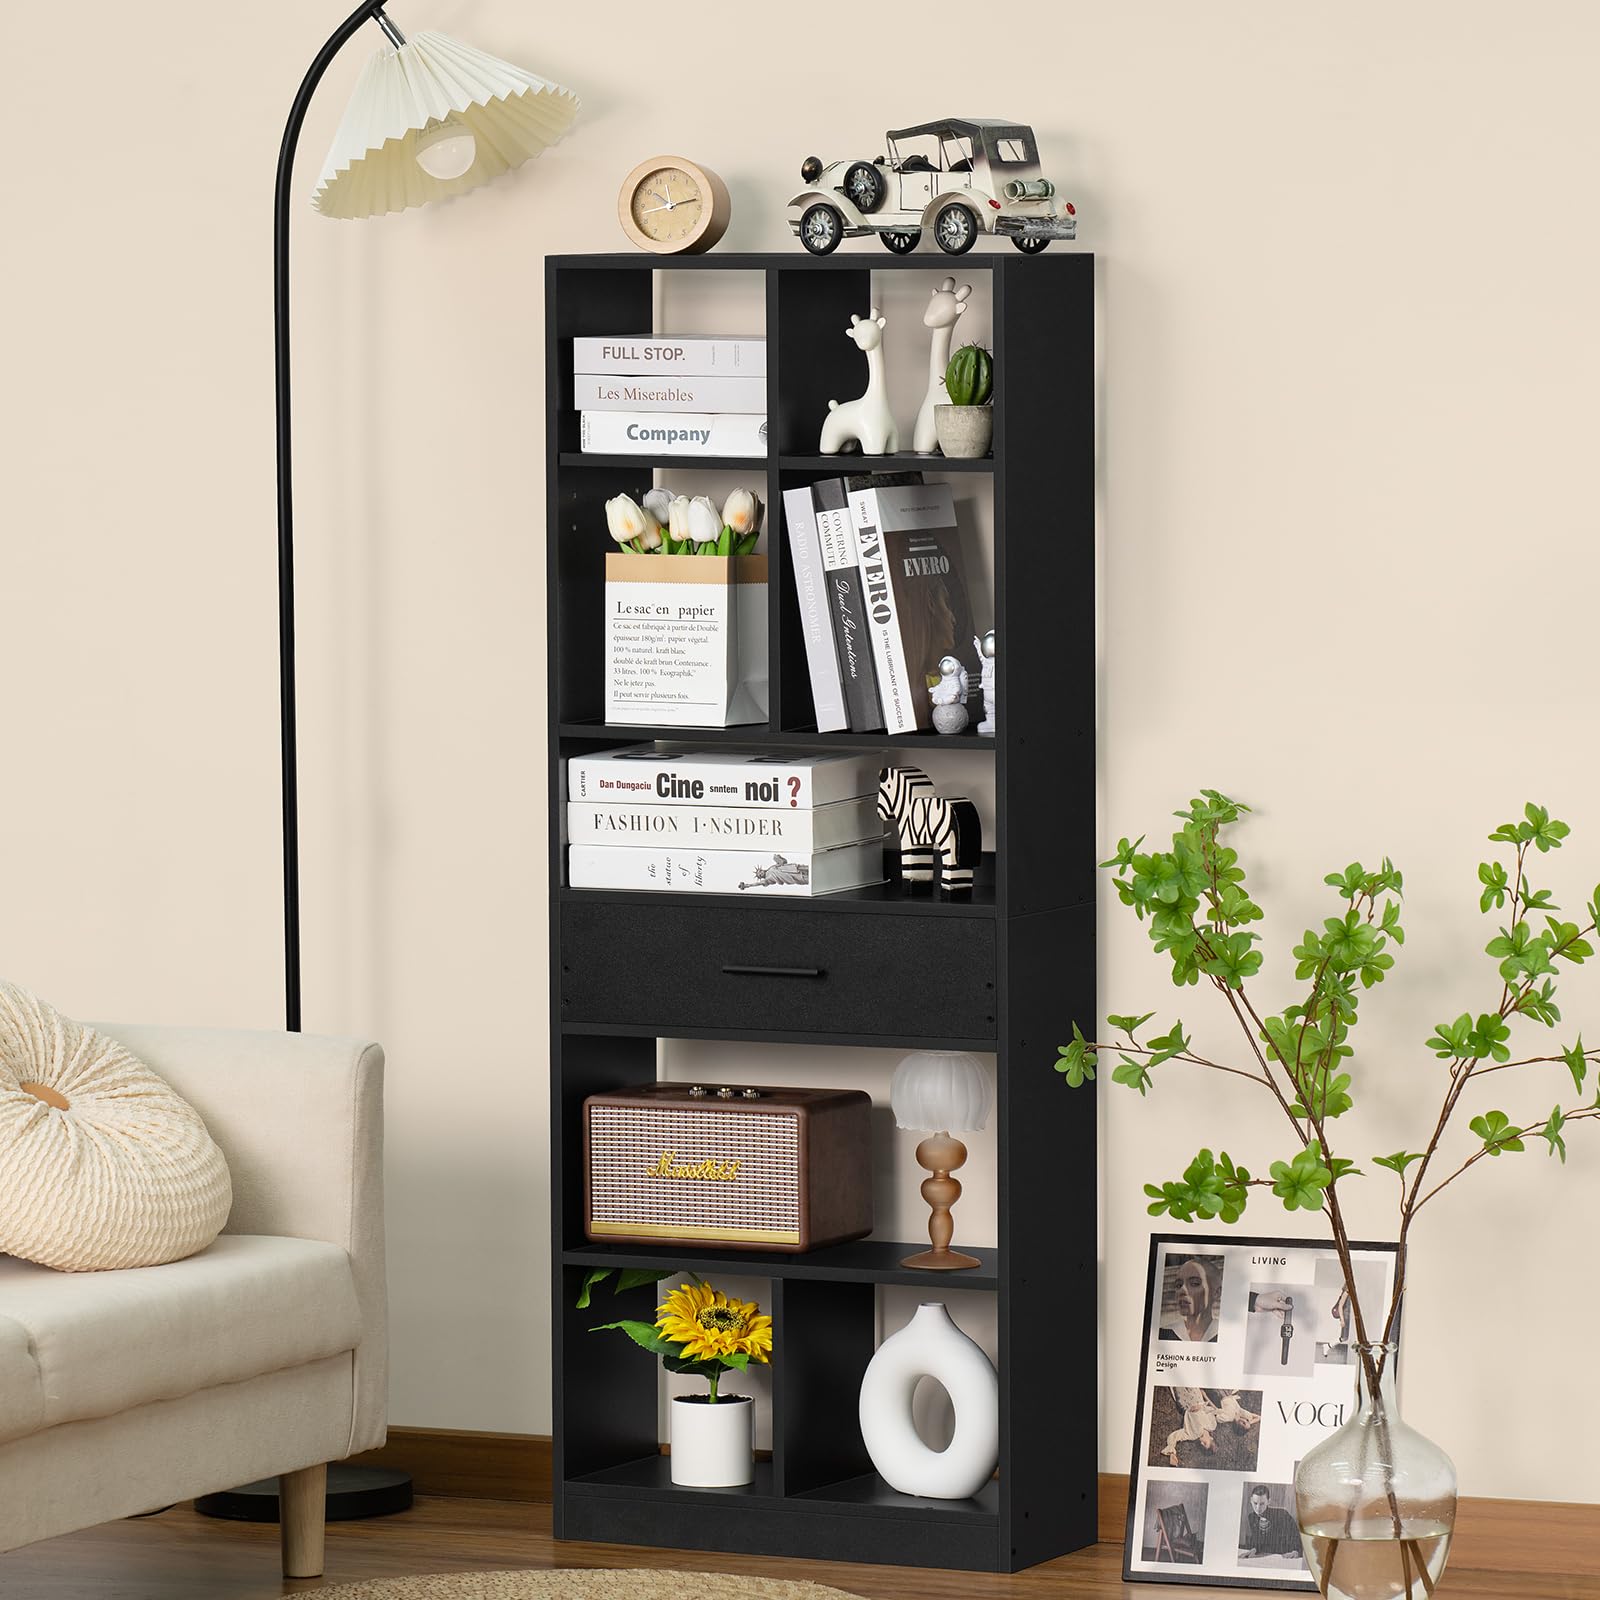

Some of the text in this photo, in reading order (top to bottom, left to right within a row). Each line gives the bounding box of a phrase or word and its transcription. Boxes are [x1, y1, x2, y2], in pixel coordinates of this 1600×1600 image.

[602, 346, 685, 360] FULL STOP.
[598, 386, 694, 402] Les Miserables
[626, 424, 711, 445] Company
[859, 501, 868, 524] SWEAT
[820, 513, 837, 567] COMMUTE
[832, 511, 849, 566] COVERING
[859, 525, 892, 625] EVERO
[903, 555, 950, 577] EVERO
[795, 520, 822, 644] RADIO ASTRONOMER
[617, 601, 632, 614] Le
[656, 605, 669, 614] en
[678, 604, 715, 619] papier
[885, 650, 897, 687] LUBRICANT
[892, 687, 898, 698] OF
[893, 698, 904, 729] SUCCESS
[599, 772, 801, 807] Dan Dungaciu Cine snntem noi ?
[594, 813, 679, 832] FASHION
[678, 864, 690, 877] of
[1252, 1256, 1287, 1266] LIVING
